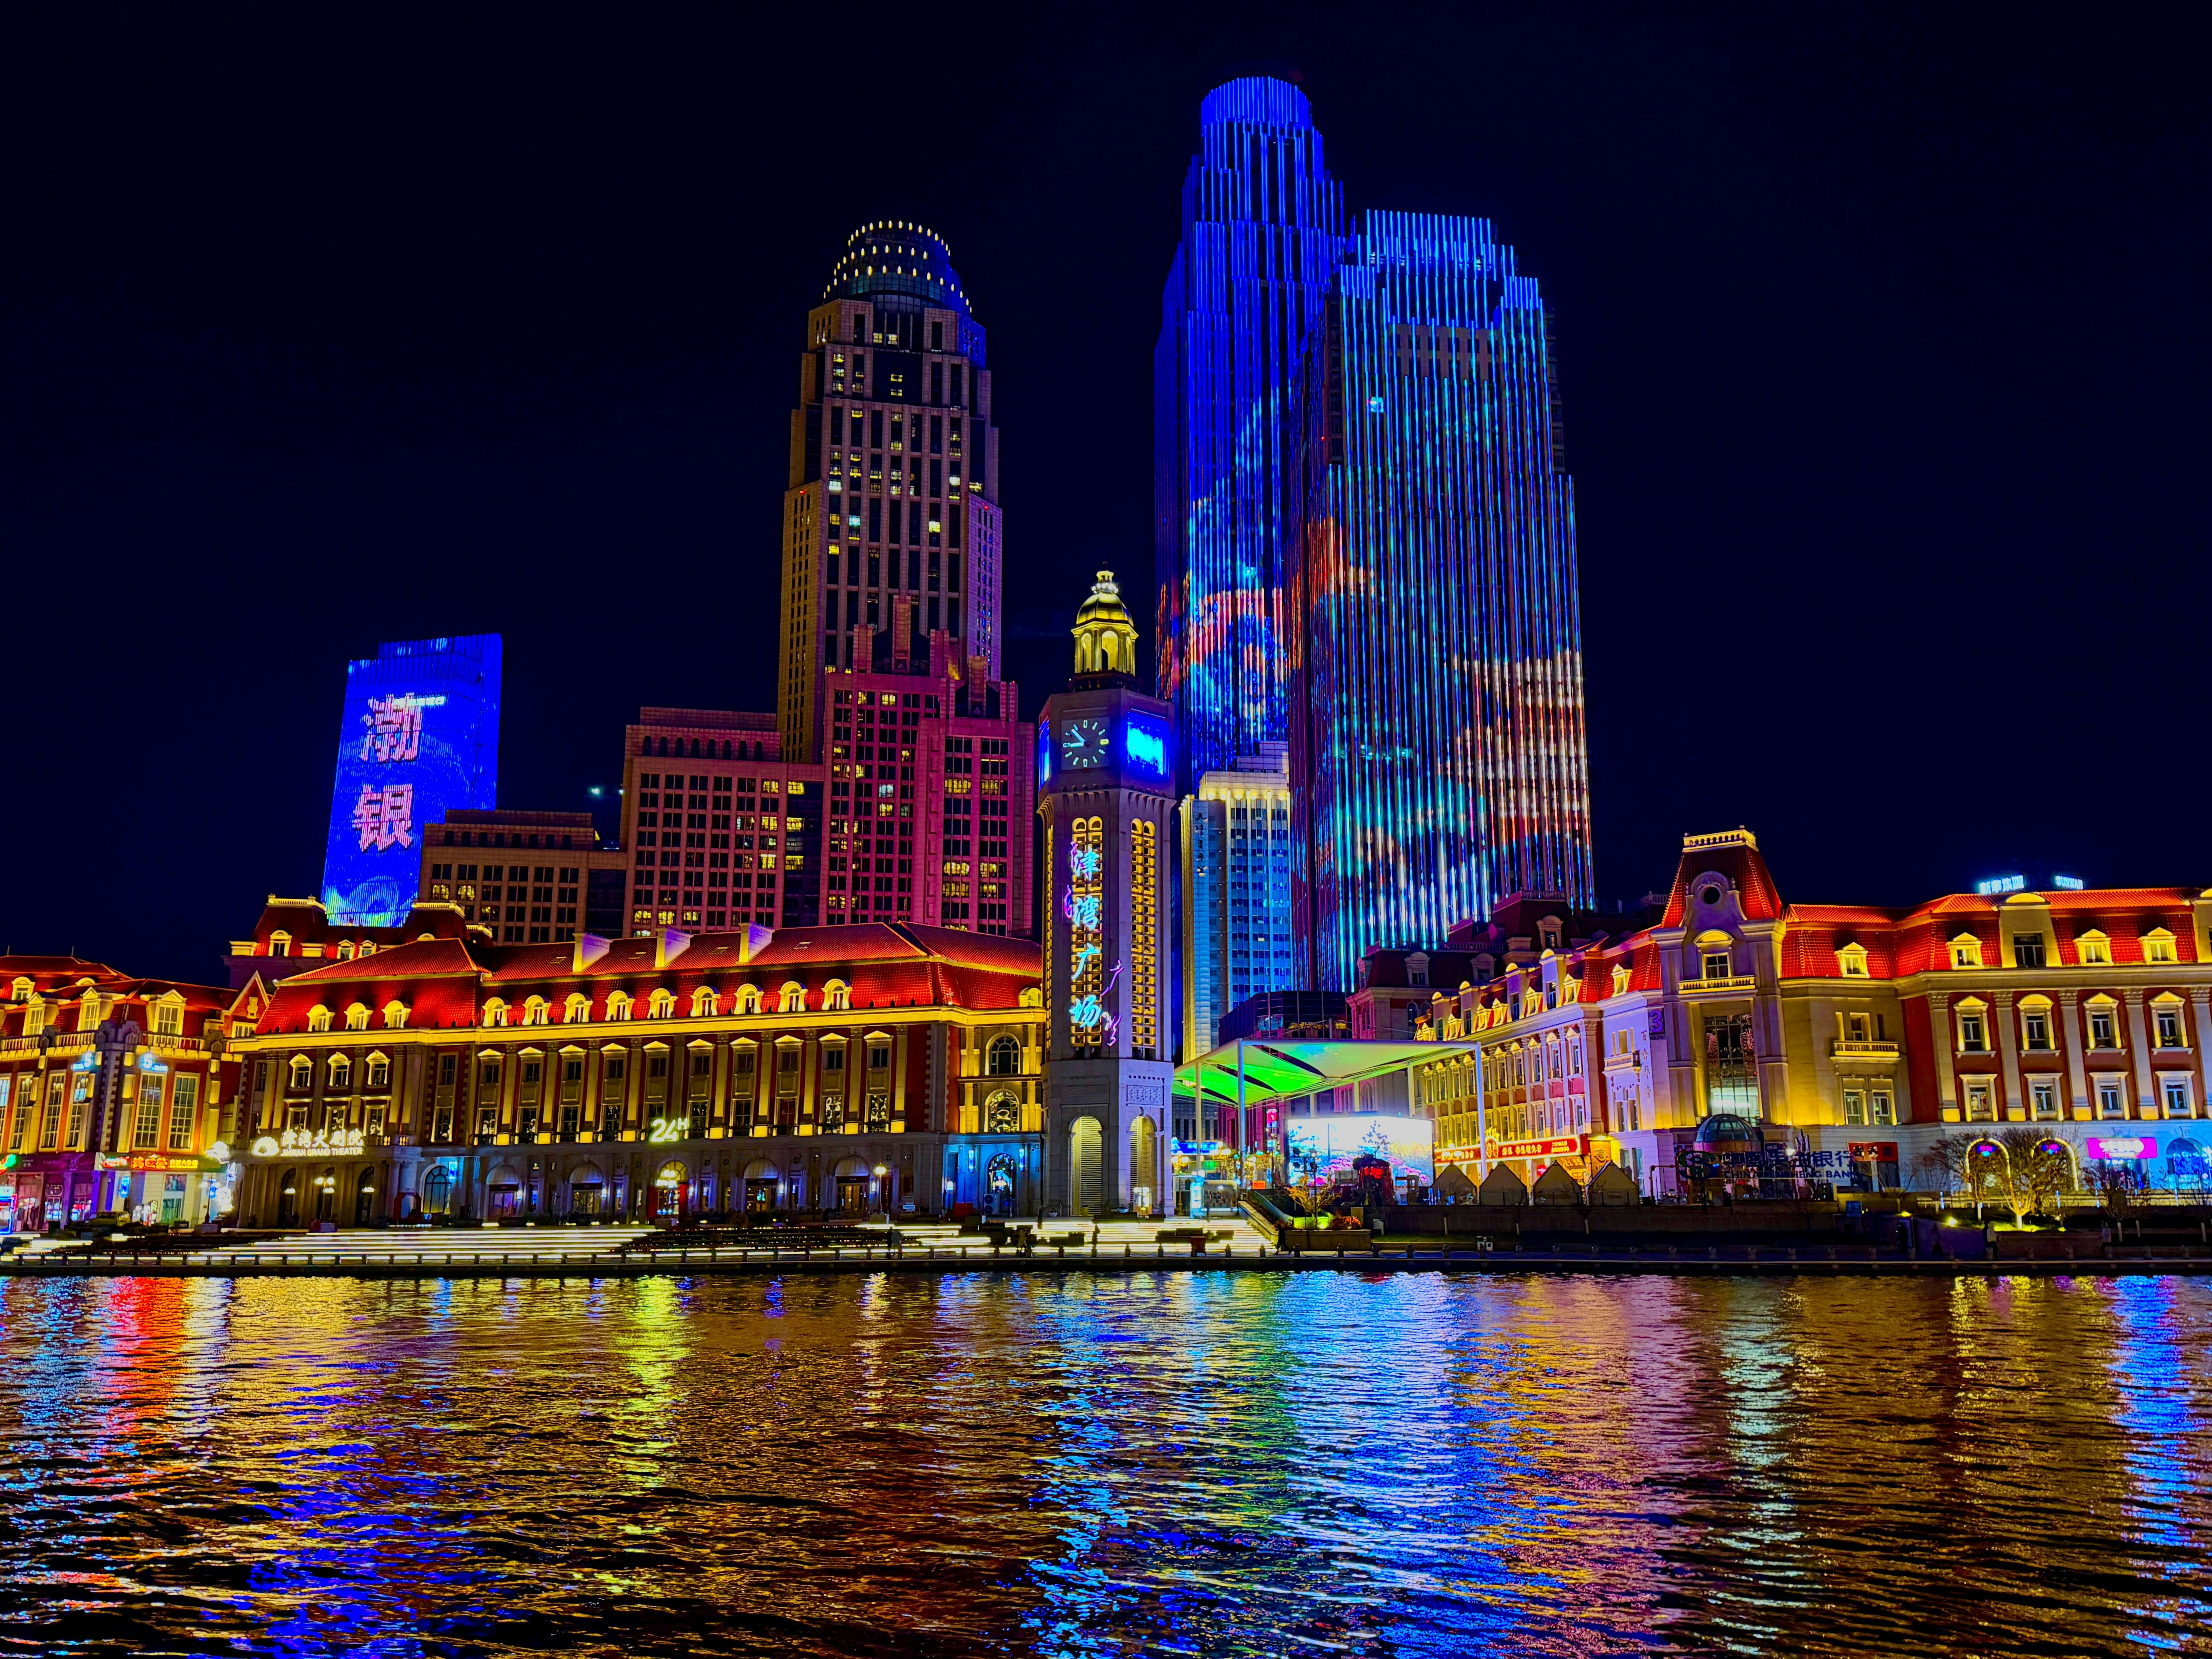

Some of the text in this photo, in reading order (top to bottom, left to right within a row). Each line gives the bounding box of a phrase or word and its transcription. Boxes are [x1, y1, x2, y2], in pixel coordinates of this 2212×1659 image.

[352, 692, 423, 852] 渤银
[1069, 843, 1102, 1028] 津湾广场
[1650, 1010, 1663, 1033] 3
[282, 1128, 363, 1149] 津湾大剧院
[651, 1117, 688, 1142] 24H
[280, 1146, 363, 1157] JINWAN GRAND THEATER
